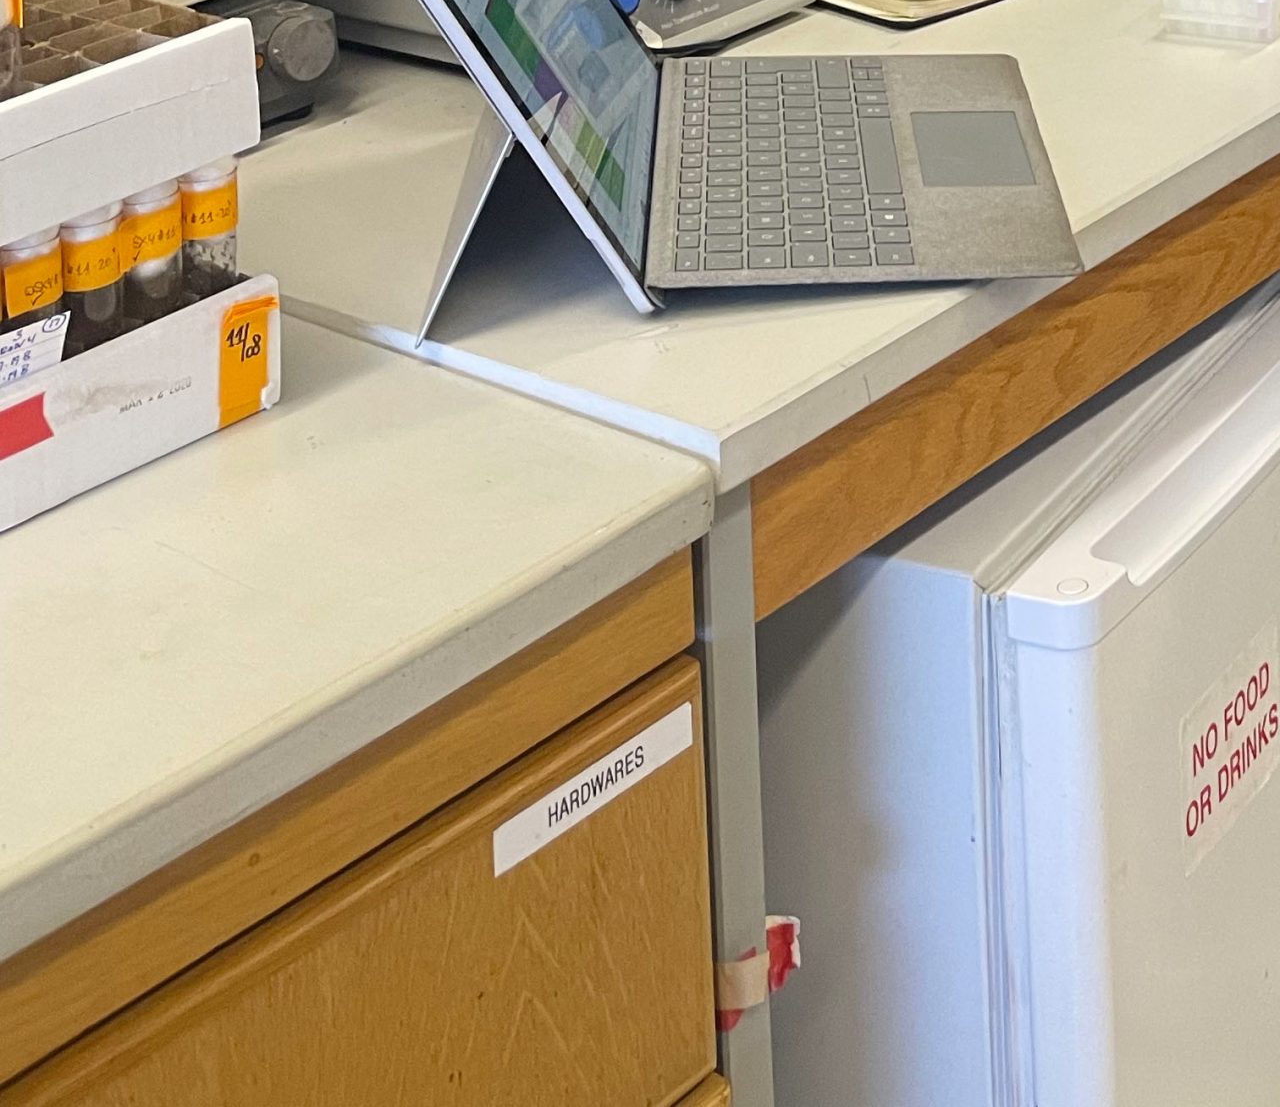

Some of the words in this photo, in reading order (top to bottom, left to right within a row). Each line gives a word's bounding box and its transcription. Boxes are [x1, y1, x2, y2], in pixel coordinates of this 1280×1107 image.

[225, 321, 262, 362] 11/08
[1192, 723, 1217, 777] NO
[1223, 662, 1270, 742] FOOD
[547, 745, 645, 828] HARDWARES
[1185, 784, 1212, 837] OR
[1217, 703, 1280, 804] DRINKS
